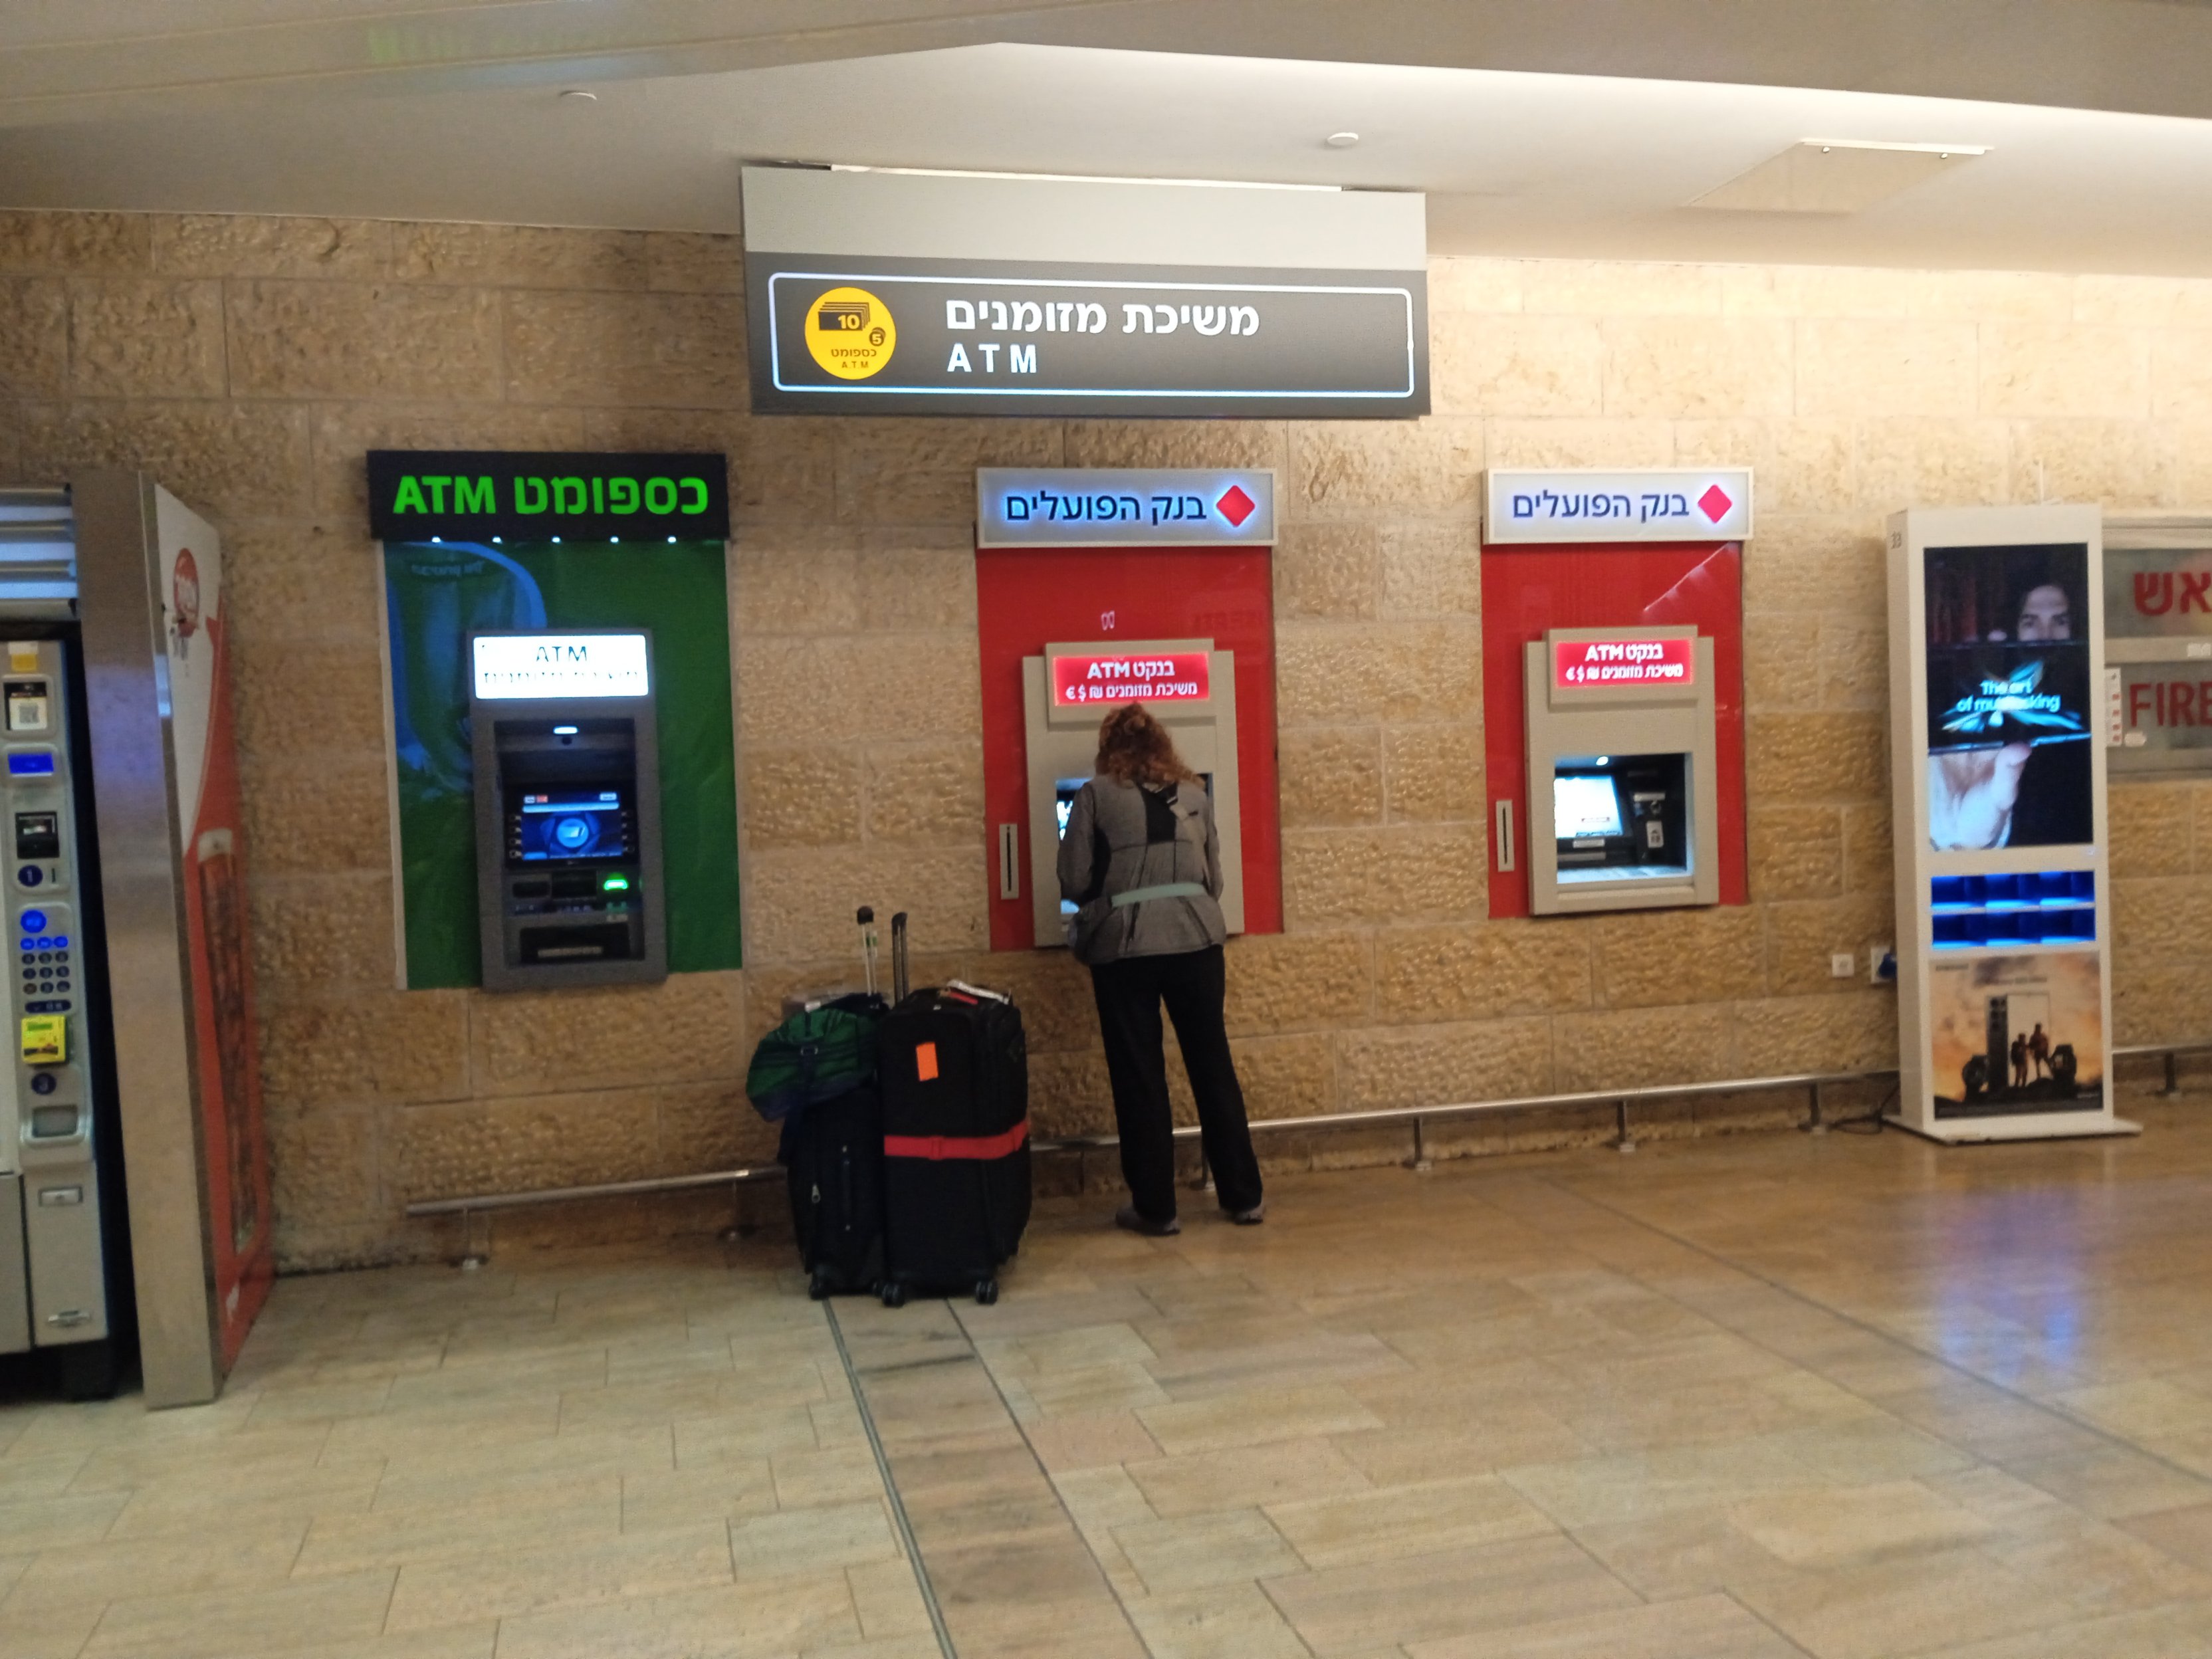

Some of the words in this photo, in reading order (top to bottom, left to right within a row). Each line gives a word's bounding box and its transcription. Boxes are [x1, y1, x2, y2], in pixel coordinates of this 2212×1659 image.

[837, 314, 860, 330] 10
[946, 299, 1108, 334] מזומנים
[1122, 303, 1260, 336] משיכת
[871, 333, 883, 346] 5
[830, 348, 877, 358] כספומט
[947, 342, 1037, 374] ATM
[392, 475, 497, 514] ATM
[514, 475, 709, 515] כספומט
[1512, 489, 1631, 518] הפועלים
[1006, 491, 1141, 521] הפועלים
[1151, 495, 1207, 526] בנק
[1640, 493, 1690, 524] בנק
[2134, 572, 2212, 616] אש
[536, 645, 588, 662] ATM
[1585, 643, 1624, 662] ATM
[1626, 643, 1664, 664] בנקט
[1087, 661, 1130, 679] ATM
[1132, 659, 1176, 681] בנקט
[1601, 665, 1643, 680] מזומנים
[1644, 663, 1684, 678] משיכת
[1105, 684, 1153, 699] מזומנים
[1155, 682, 1198, 697] משיכת
[2130, 681, 2212, 728] FIRE
